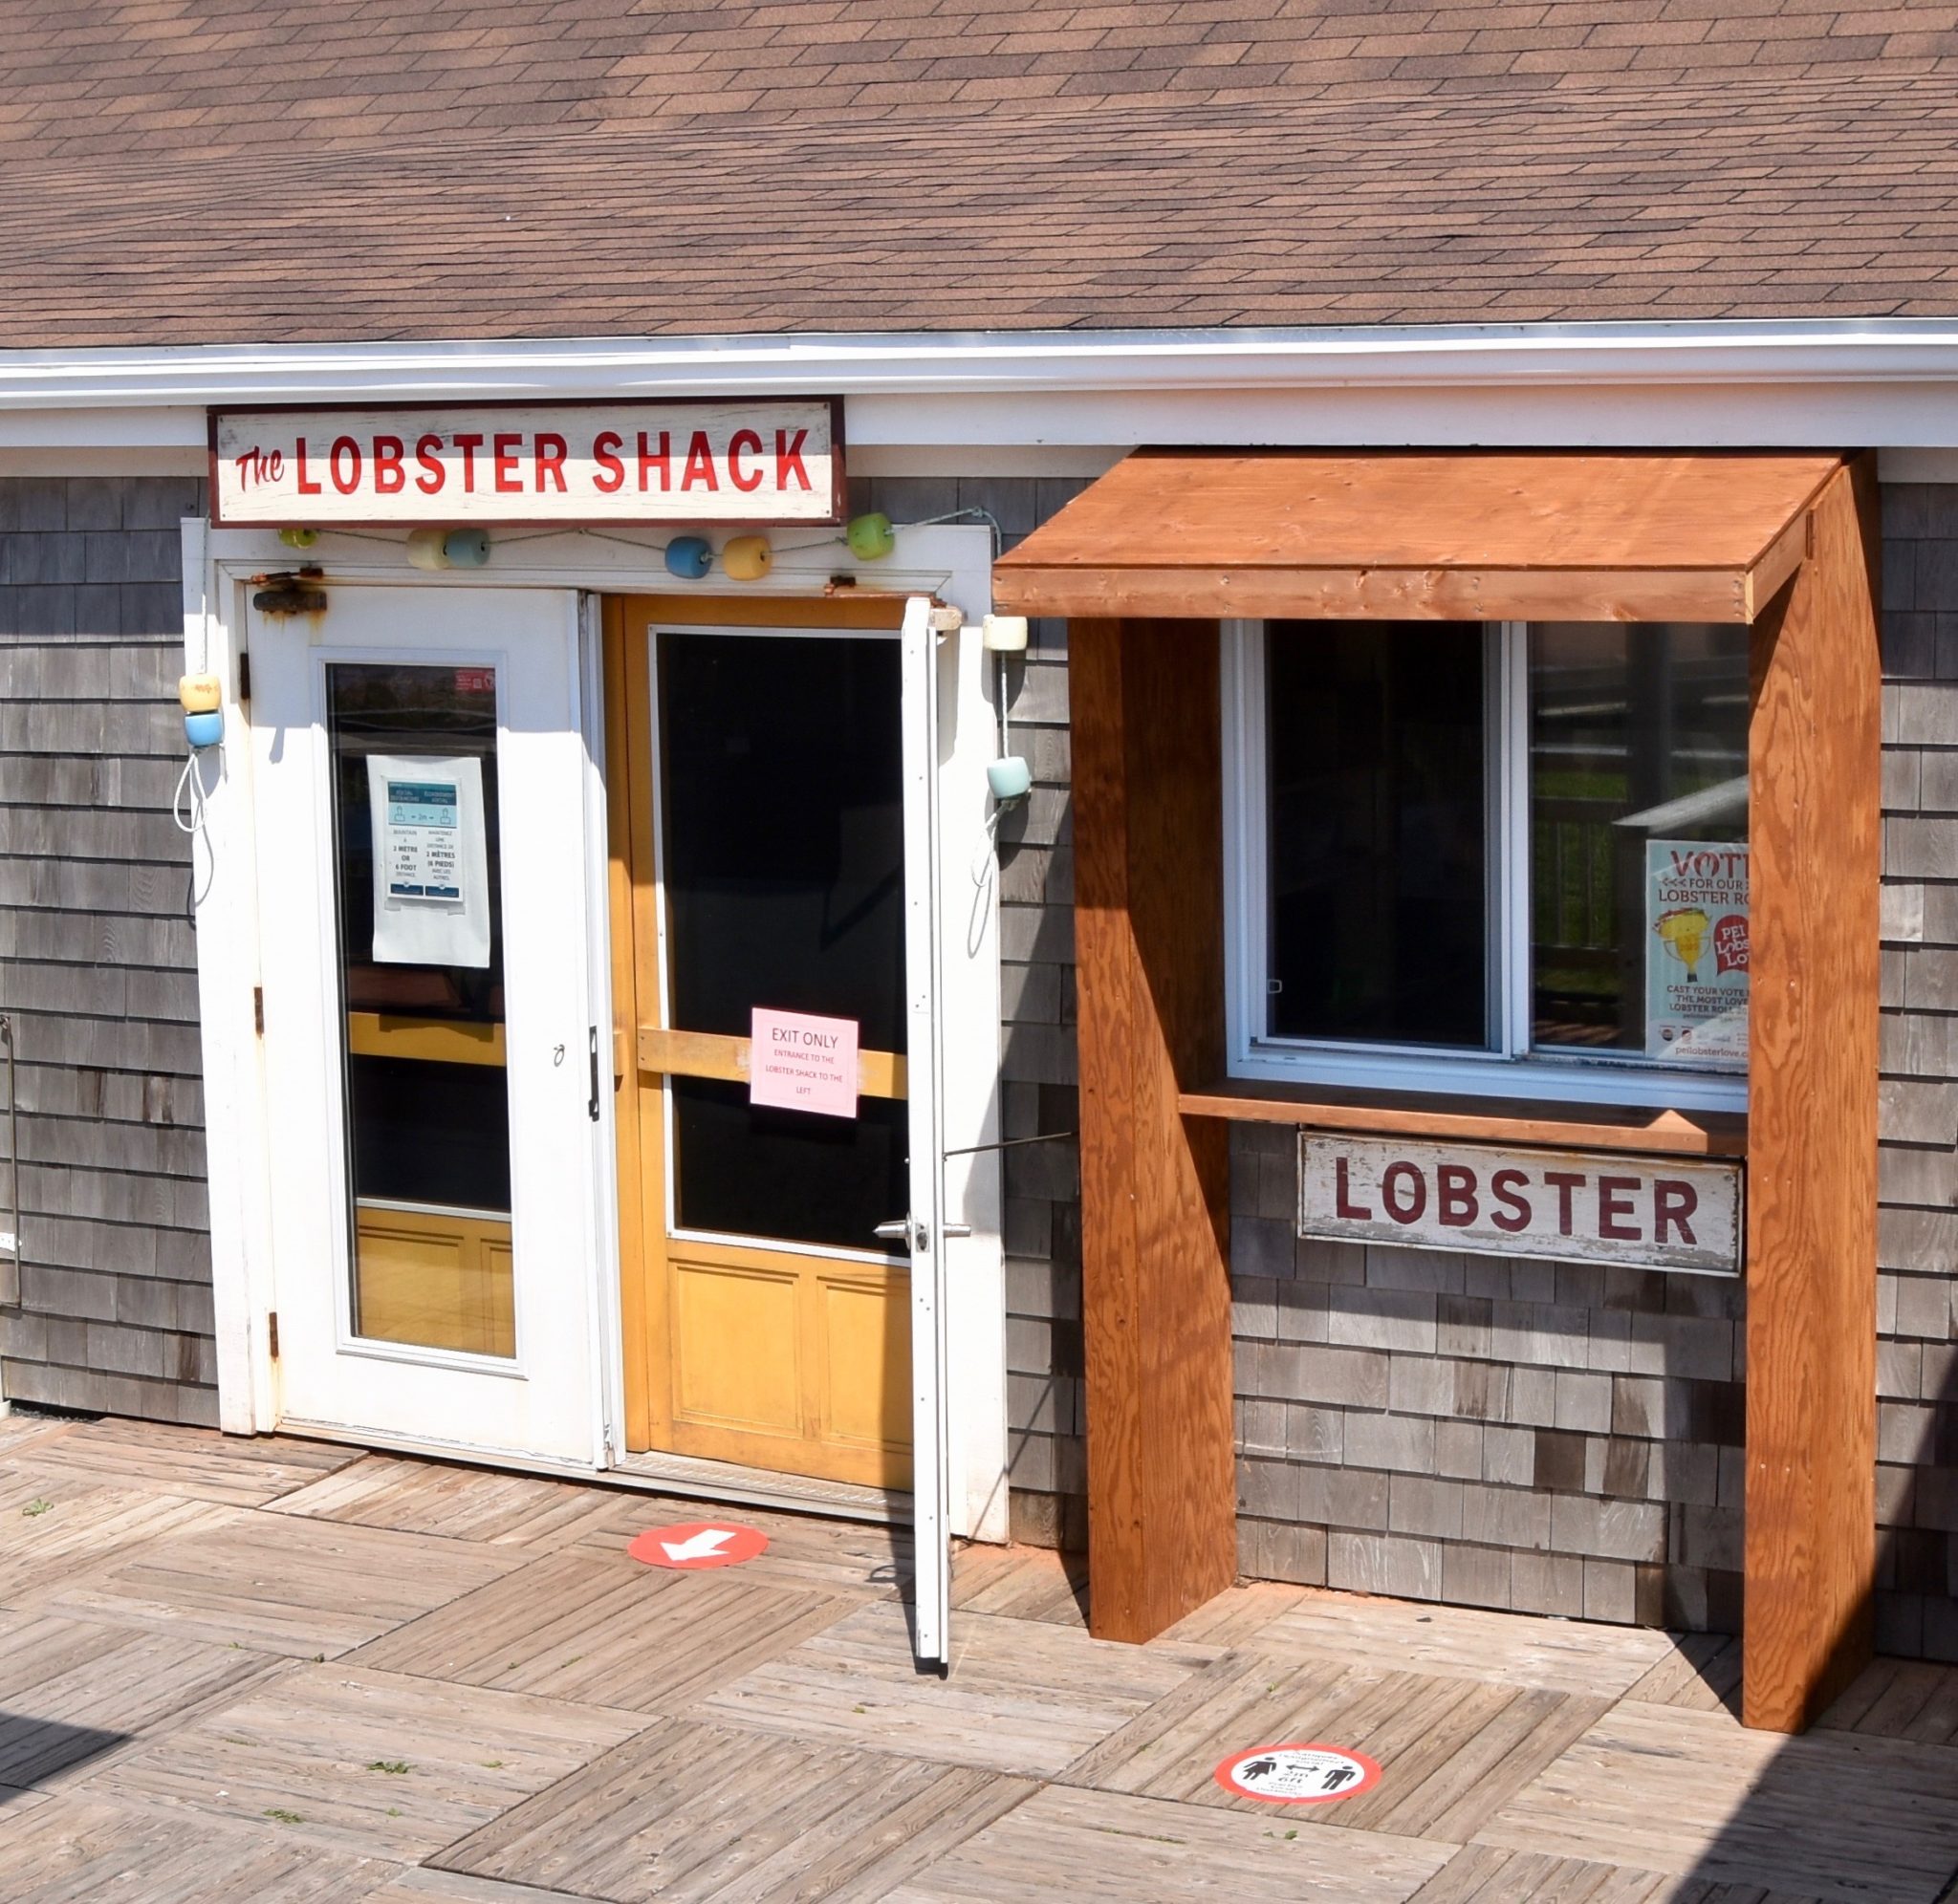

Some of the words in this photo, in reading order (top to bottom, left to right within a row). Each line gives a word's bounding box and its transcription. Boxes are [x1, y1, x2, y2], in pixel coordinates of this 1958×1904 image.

[234, 444, 285, 493] The
[296, 433, 568, 494] LOBSTER
[591, 428, 813, 493] SHACK
[1688, 878, 1713, 889] FOR
[1716, 879, 1743, 890] OUR
[1659, 889, 1730, 904] LOBSTER
[1721, 924, 1746, 941] PEI
[1666, 984, 1690, 993] CAST
[1691, 986, 1718, 995] YOUR
[1719, 988, 1744, 997] VOTE
[1669, 1003, 1708, 1012] LOBSTER
[1696, 996, 1722, 1005] MOST
[772, 1028, 799, 1044] EXIT
[803, 1032, 838, 1049] ONLY
[773, 1049, 809, 1061] ENTRANCE
[811, 1053, 820, 1063] TO
[822, 1055, 835, 1064] THE
[1675, 1047, 1749, 1058] peilobsterlove.c
[765, 1064, 794, 1075] LOBSTER
[795, 1069, 817, 1079] SHACK
[819, 1071, 828, 1081] TO
[830, 1073, 843, 1083] THE
[796, 1086, 811, 1094] LEFT
[1336, 1156, 1698, 1245] LOBSTER
